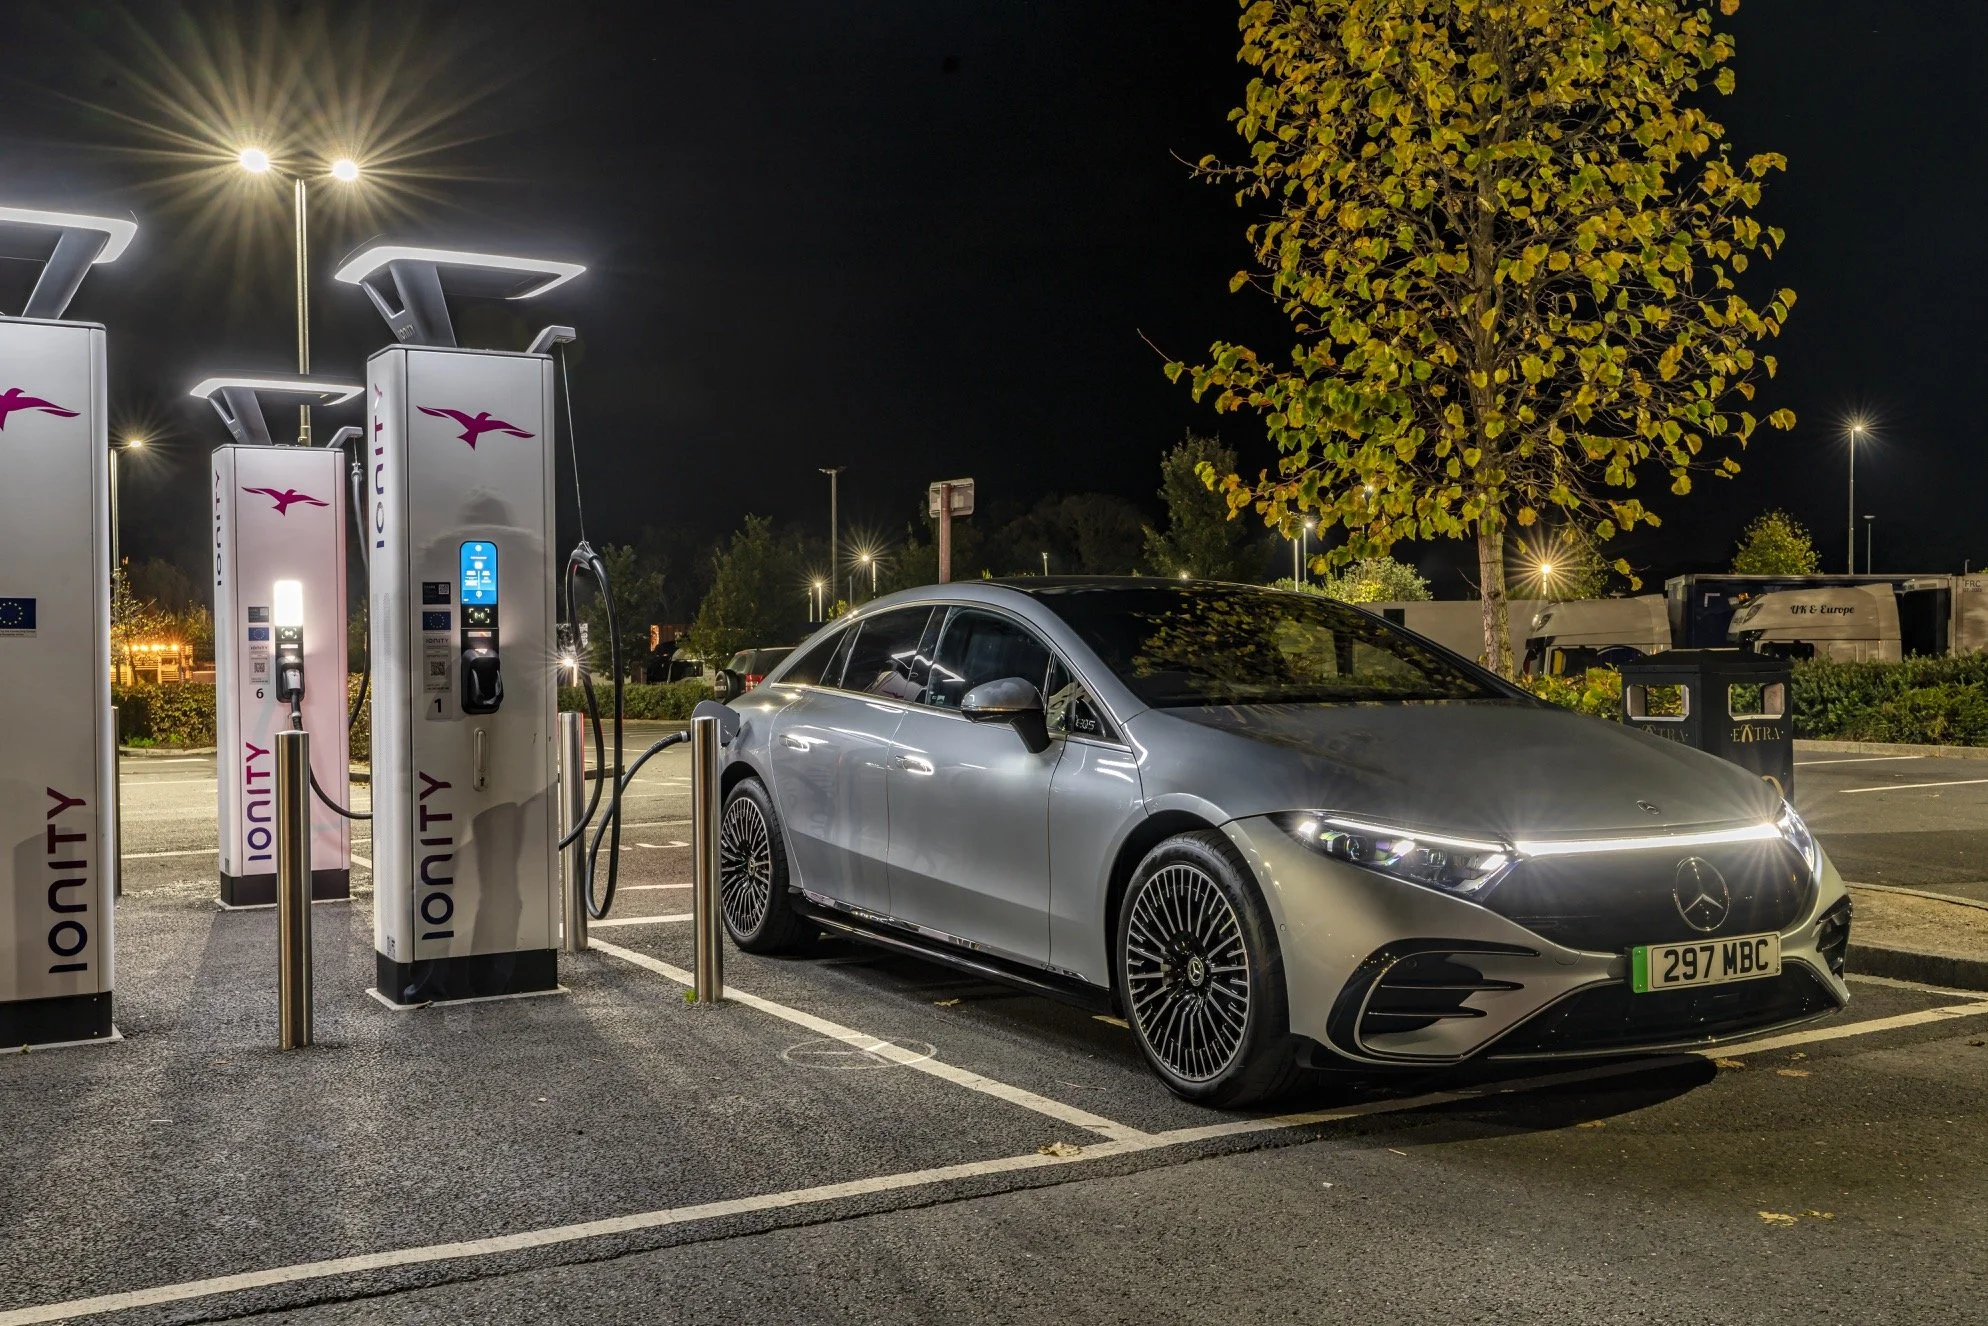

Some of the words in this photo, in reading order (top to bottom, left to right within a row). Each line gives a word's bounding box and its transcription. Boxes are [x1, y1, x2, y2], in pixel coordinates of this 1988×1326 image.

[374, 383, 385, 549] IONITY
[1964, 579, 1981, 588] FRC
[1790, 604, 1807, 615] UK
[1809, 605, 1817, 614] &
[1820, 604, 1855, 616] Europe
[256, 688, 264, 700] 6
[434, 698, 442, 714] 1
[246, 742, 272, 861] IONITY
[419, 771, 454, 940] IONITY
[47, 787, 88, 973] IONITY
[1663, 944, 1715, 983] 297
[1723, 938, 1769, 976] MBC
